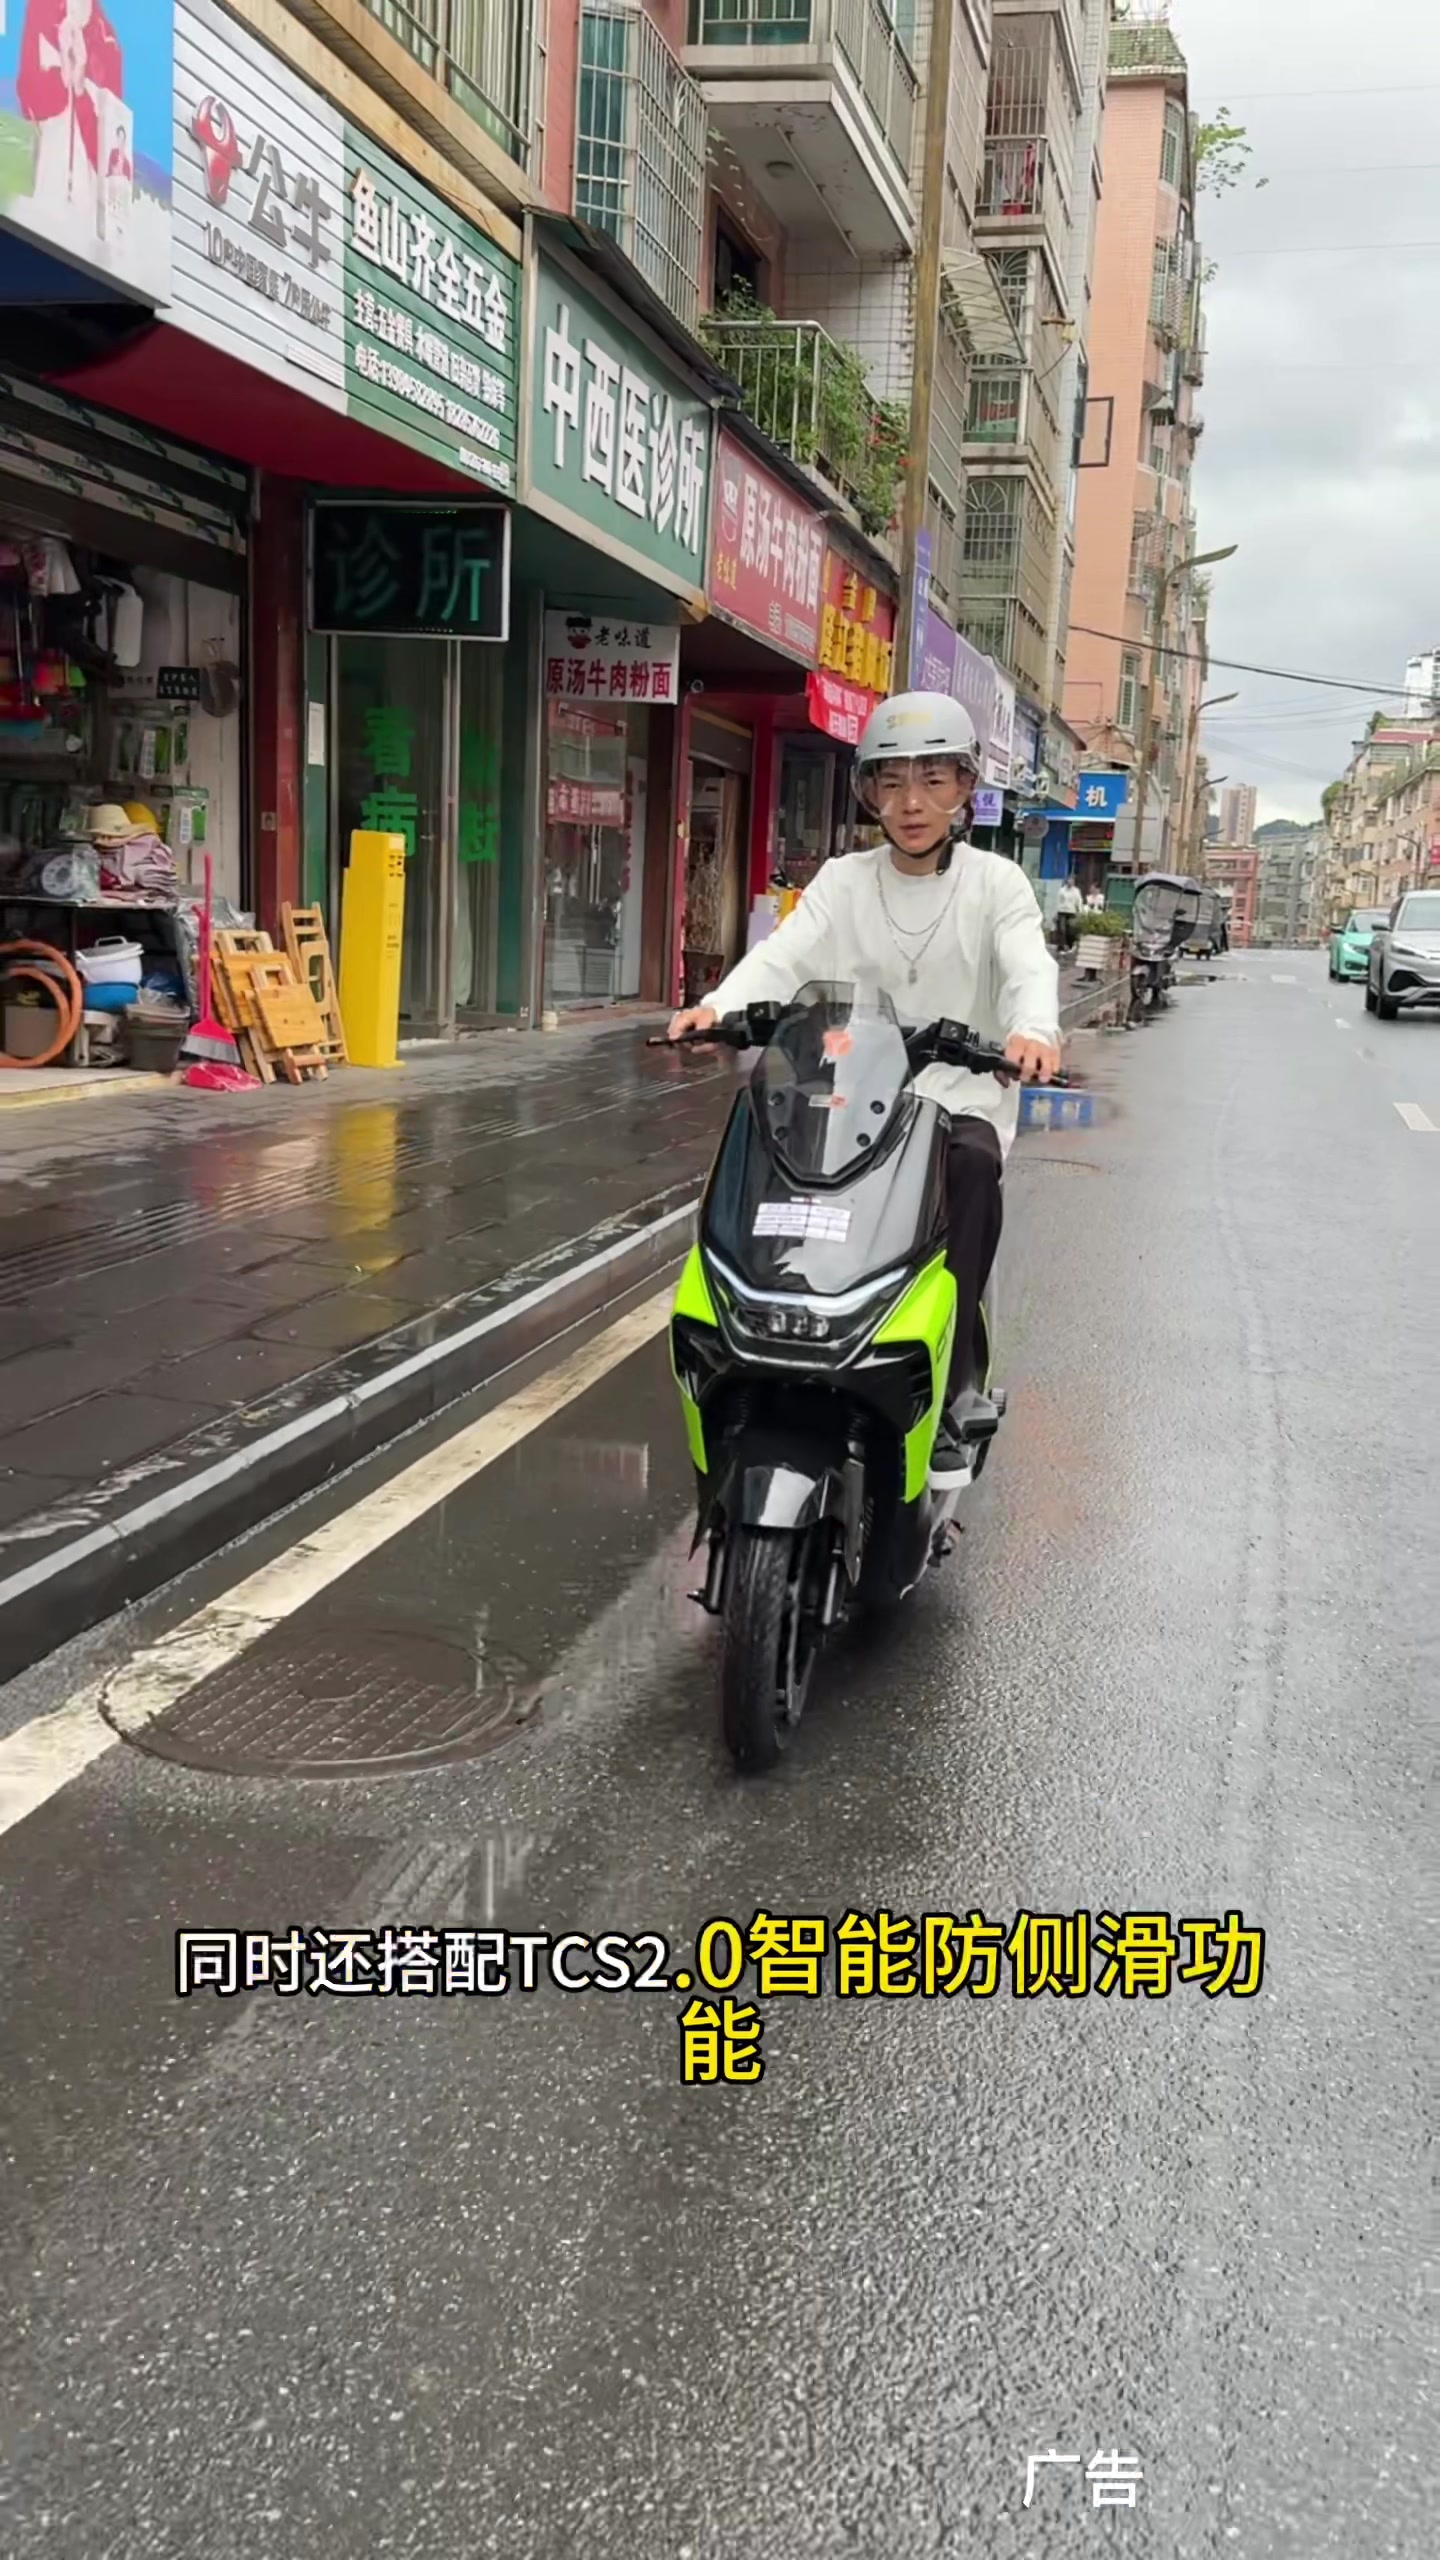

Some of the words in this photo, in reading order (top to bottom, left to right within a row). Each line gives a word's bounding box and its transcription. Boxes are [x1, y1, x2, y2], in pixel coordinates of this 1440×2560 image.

[248, 132, 332, 269] 公牛
[352, 166, 508, 354] 鱼山齐全五金
[543, 304, 706, 556] 中西医诊所
[325, 512, 491, 622] 诊所
[740, 473, 823, 613] 原汤牛肉粉面
[546, 656, 672, 699] 原汤牛肉粉面
[594, 627, 653, 650] 老味道
[1085, 784, 1108, 808] 机
